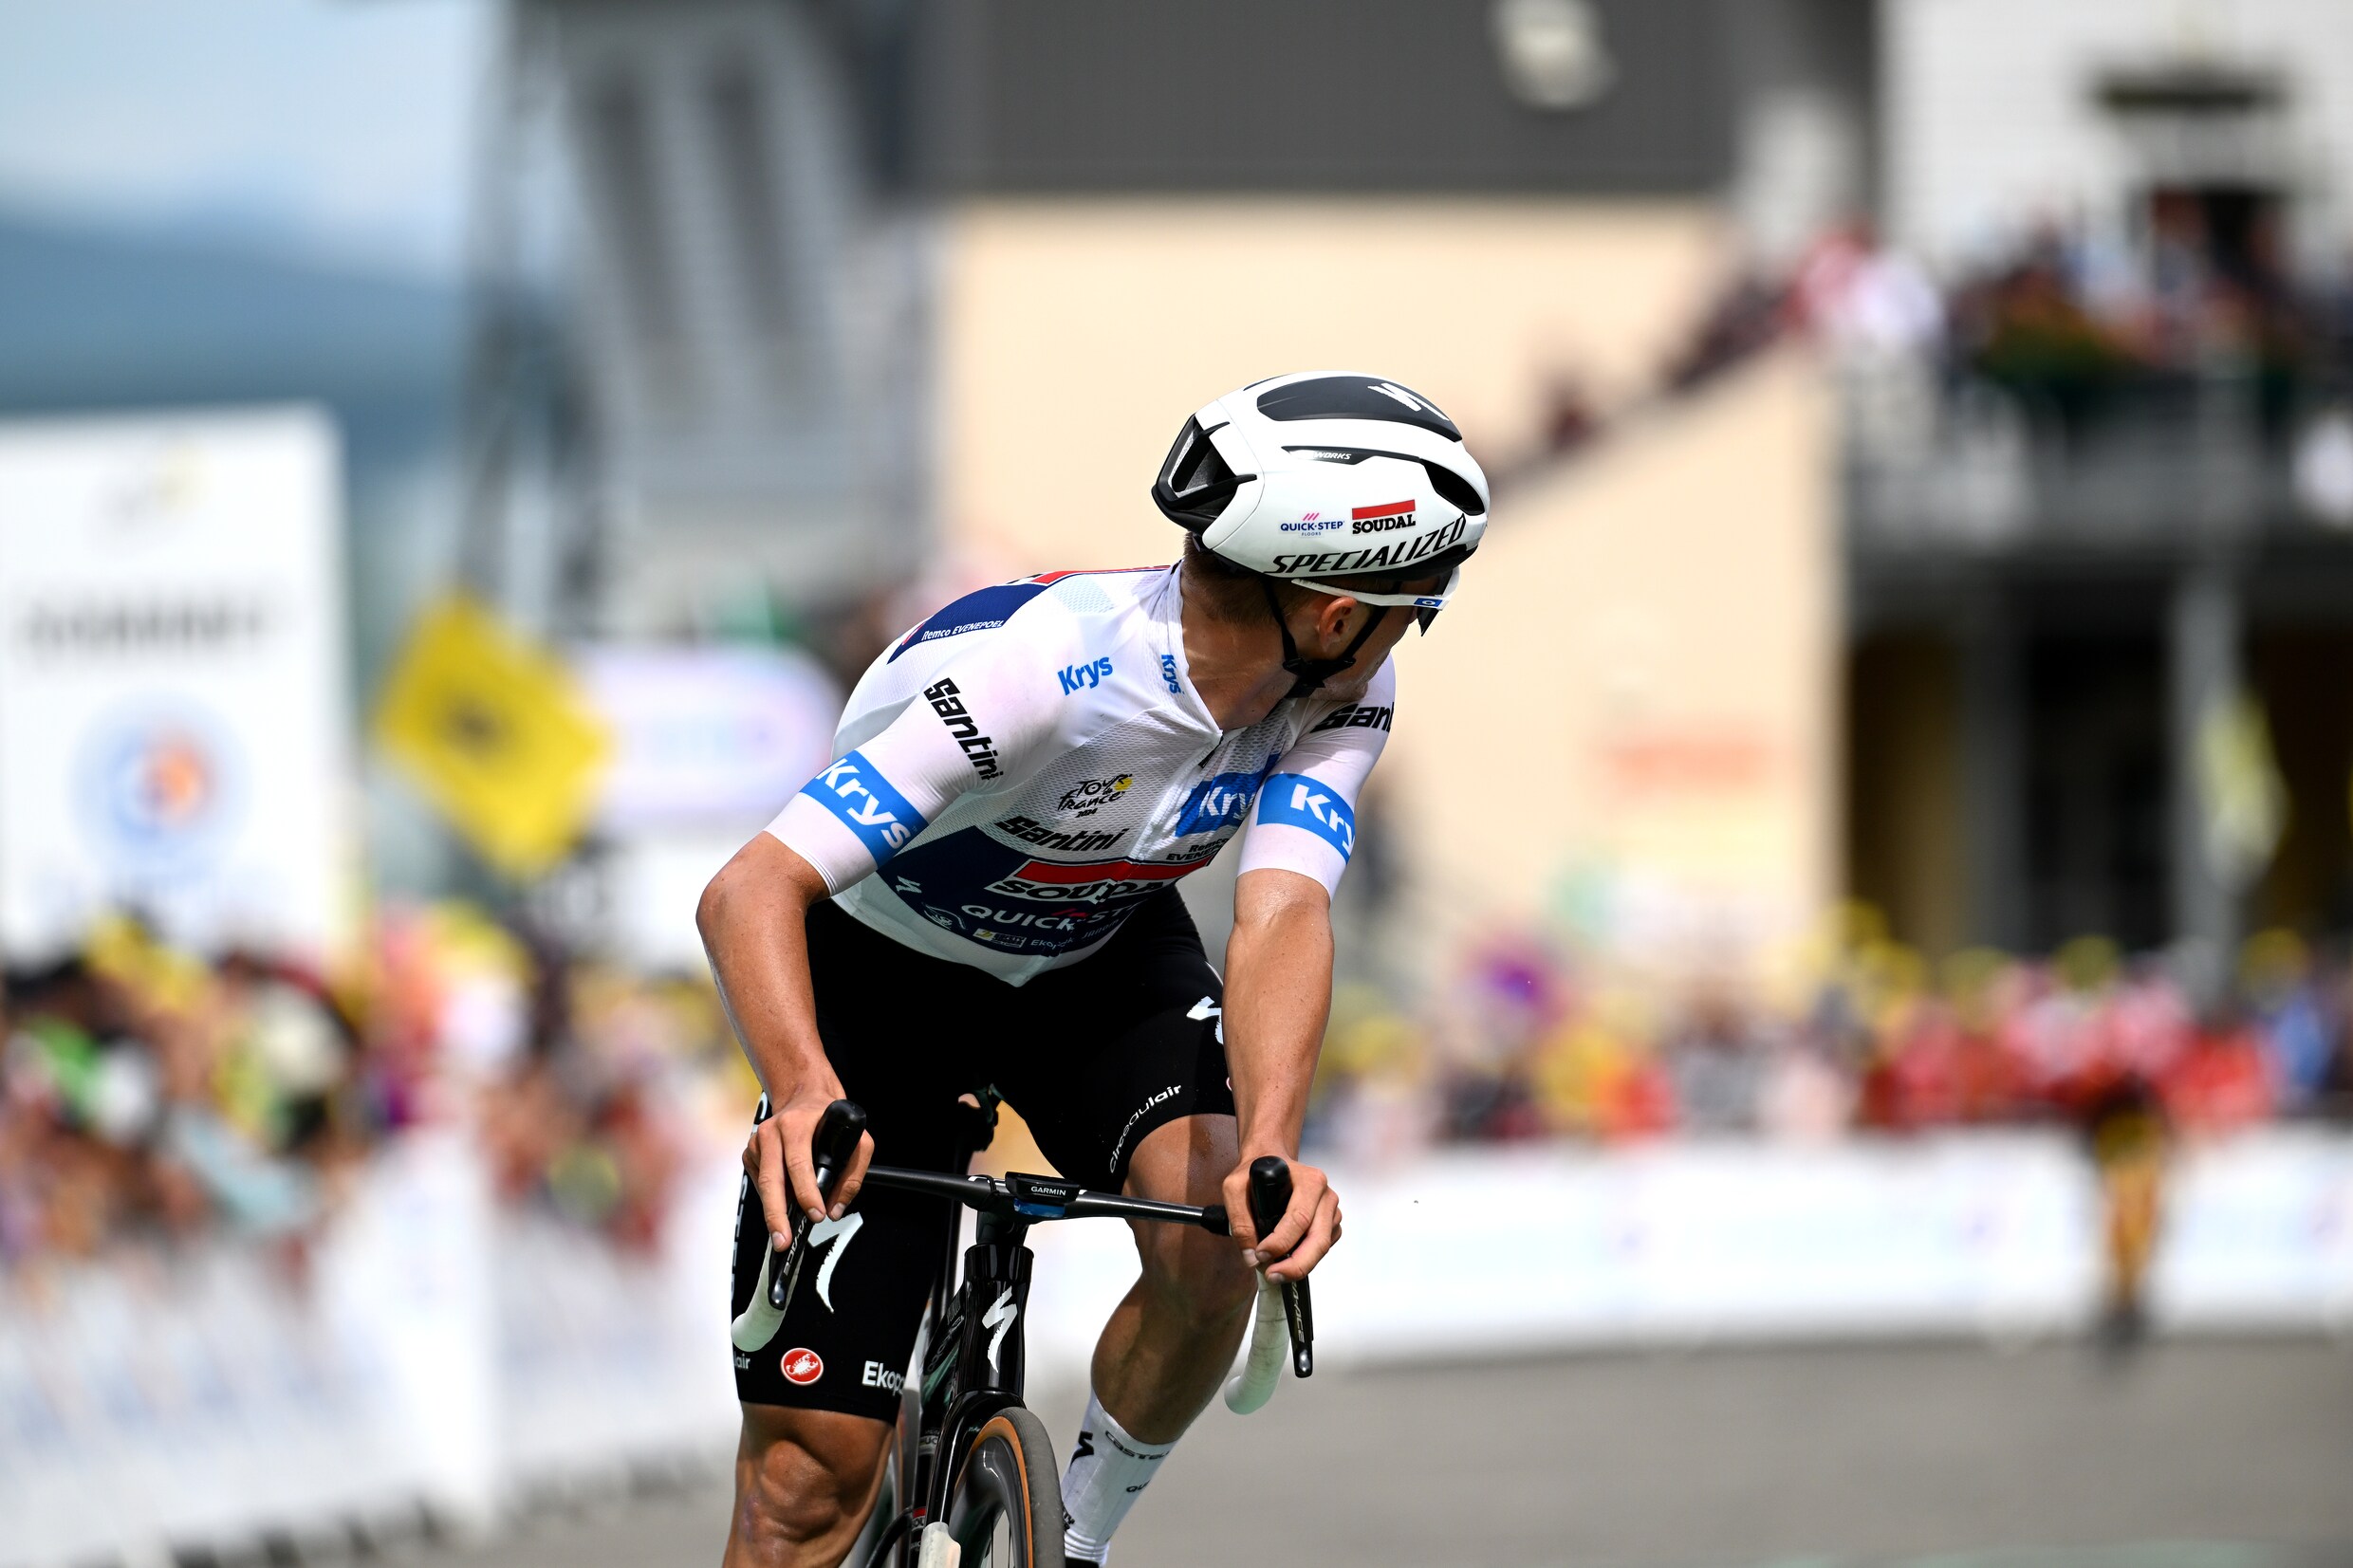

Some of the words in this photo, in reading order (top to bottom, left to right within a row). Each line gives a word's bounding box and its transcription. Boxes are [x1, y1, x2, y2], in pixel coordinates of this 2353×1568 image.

[1352, 513, 1417, 535] SOUDAL
[1263, 512, 1467, 574] SPECIALIZED
[921, 629, 951, 641] Remco
[952, 619, 1005, 636] EVENEPOEL
[1057, 656, 1113, 696] Krys
[1160, 654, 1182, 694] Krys
[814, 758, 912, 850] Krys
[1074, 807, 1098, 818] 2024
[1198, 785, 1256, 820] Kry
[1289, 783, 1355, 857] Kry
[996, 879, 1164, 903] SOUDA
[1030, 1185, 1066, 1197] GARMIN
[862, 1359, 905, 1395] Ekop
